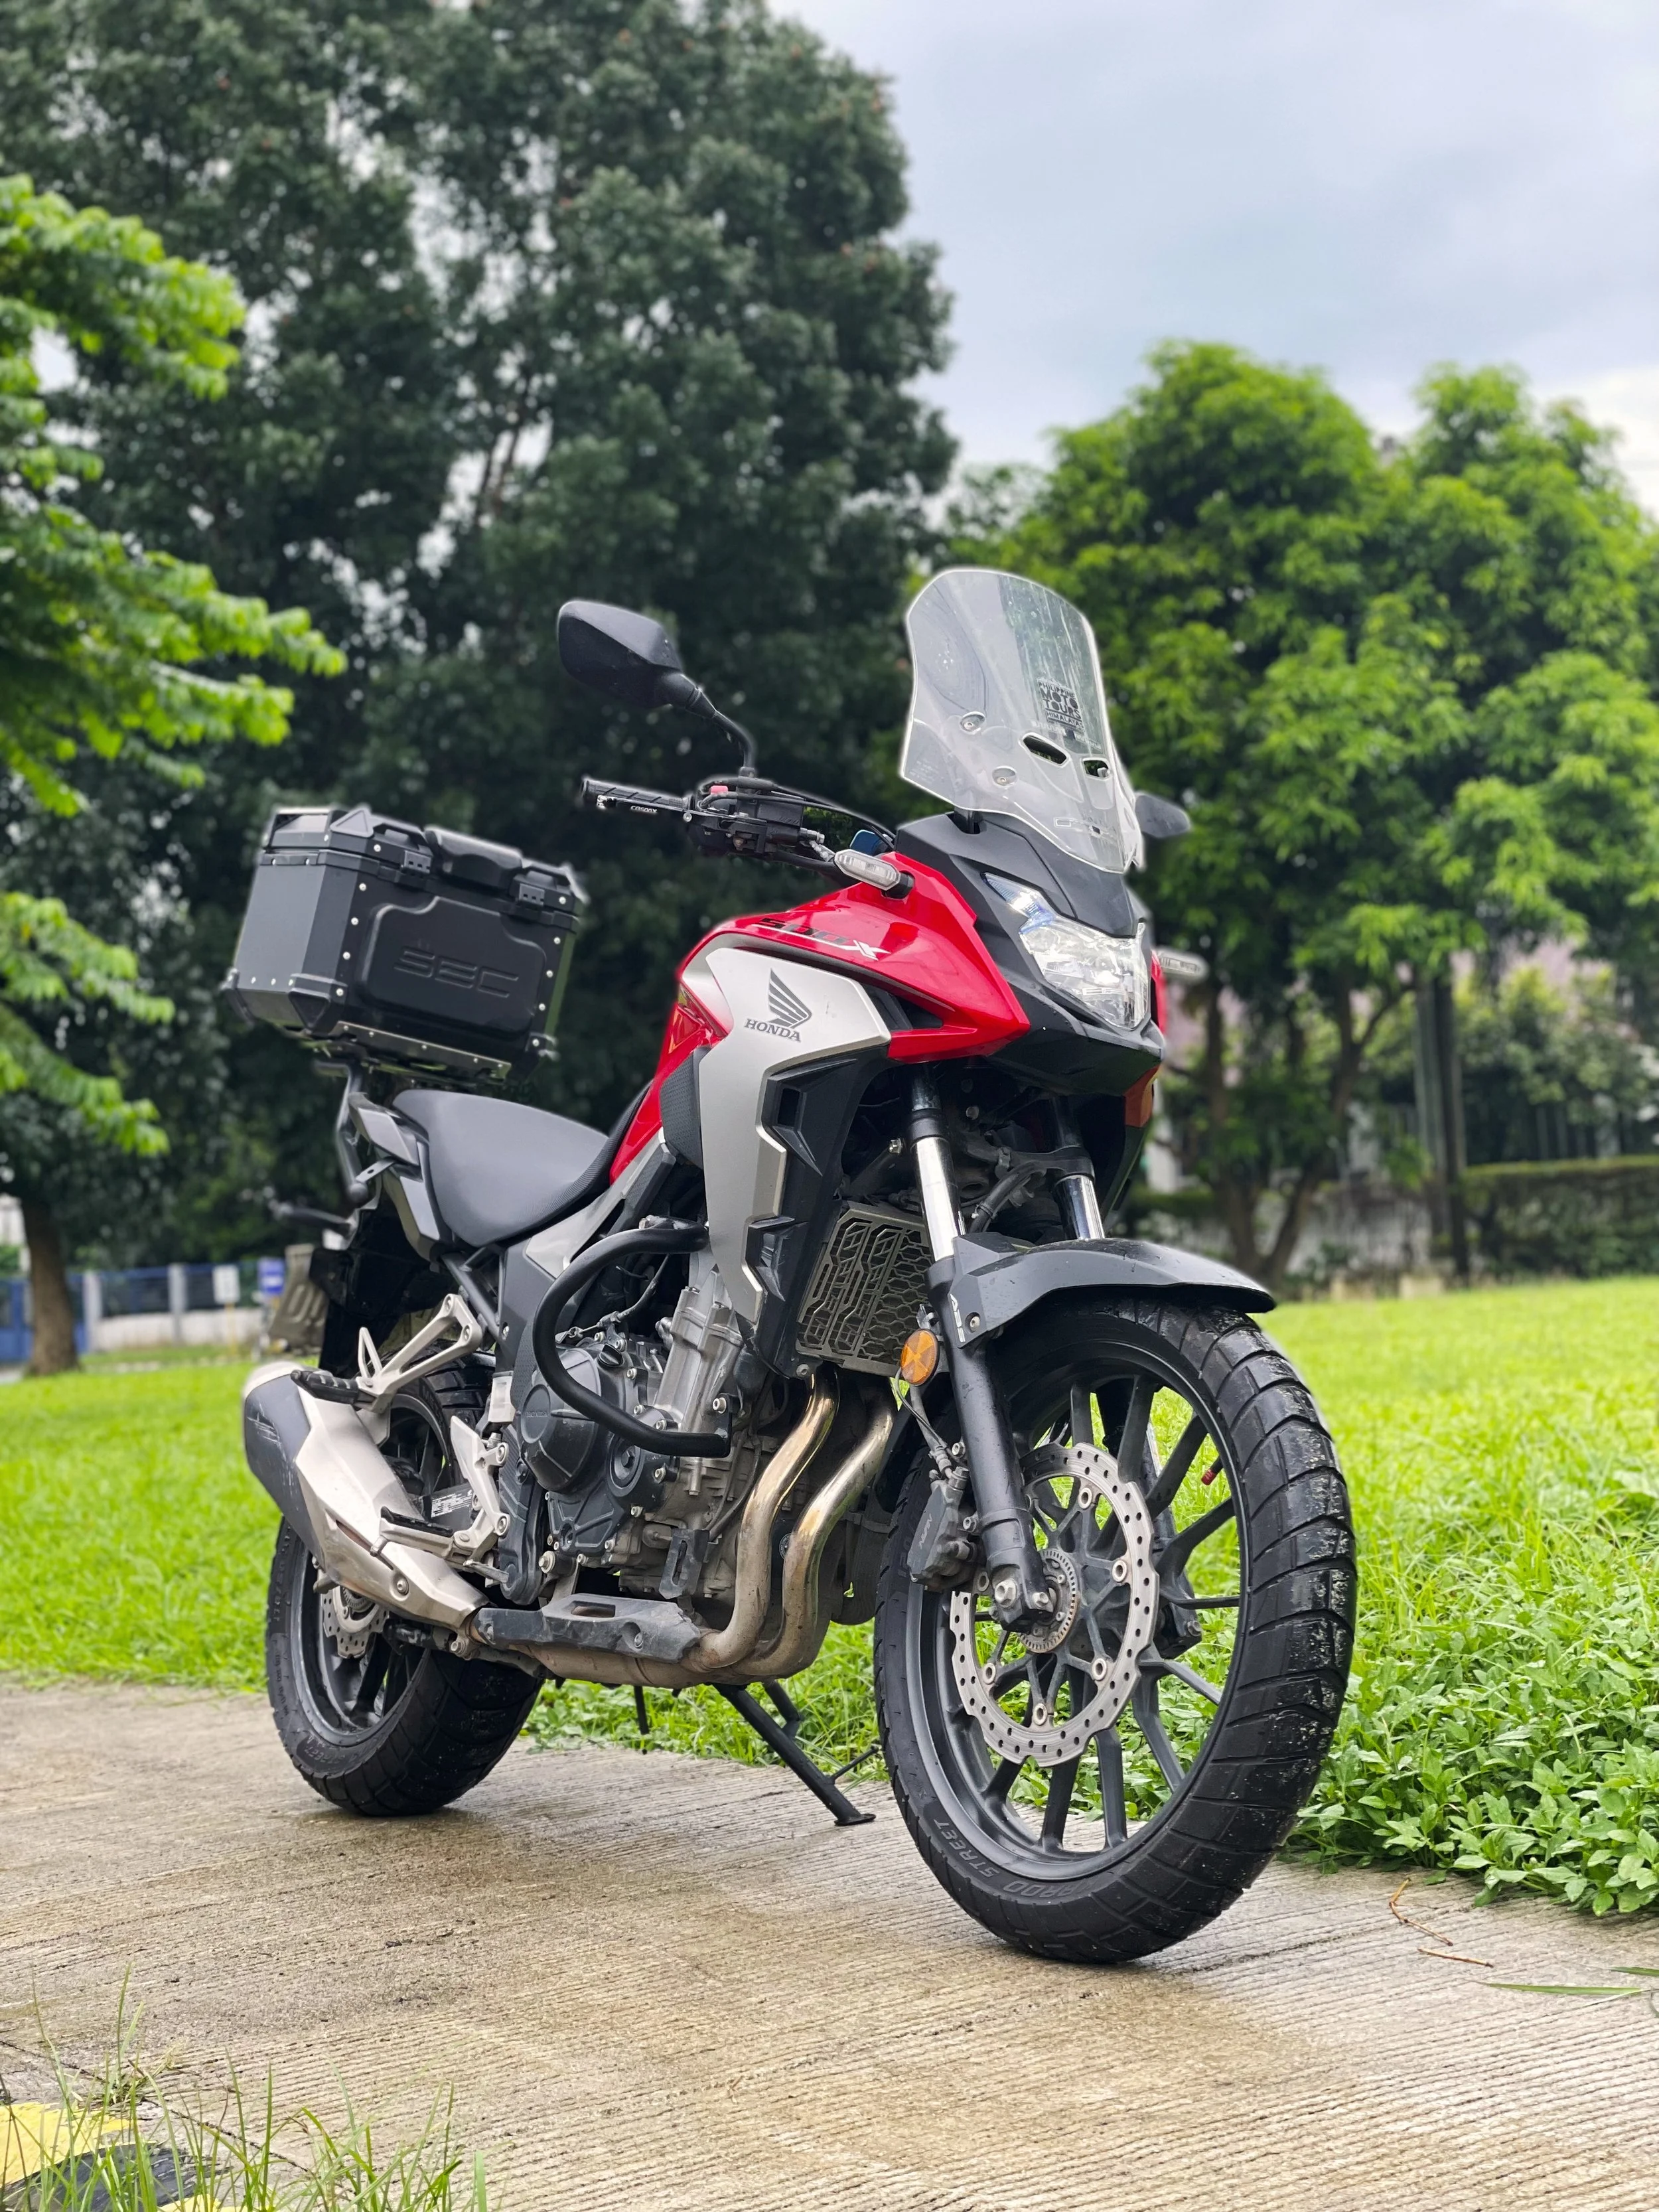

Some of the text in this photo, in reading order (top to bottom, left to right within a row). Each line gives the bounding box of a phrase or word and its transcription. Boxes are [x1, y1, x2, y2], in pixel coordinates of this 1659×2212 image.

[1039, 682, 1075, 698] PHILIPPINE
[1040, 688, 1078, 709] MOTO
[1043, 699, 1082, 719] TOURS
[394, 946, 519, 998] SEC
[744, 1019, 802, 1043] HONDA
[934, 1818, 1000, 1878] STREET
